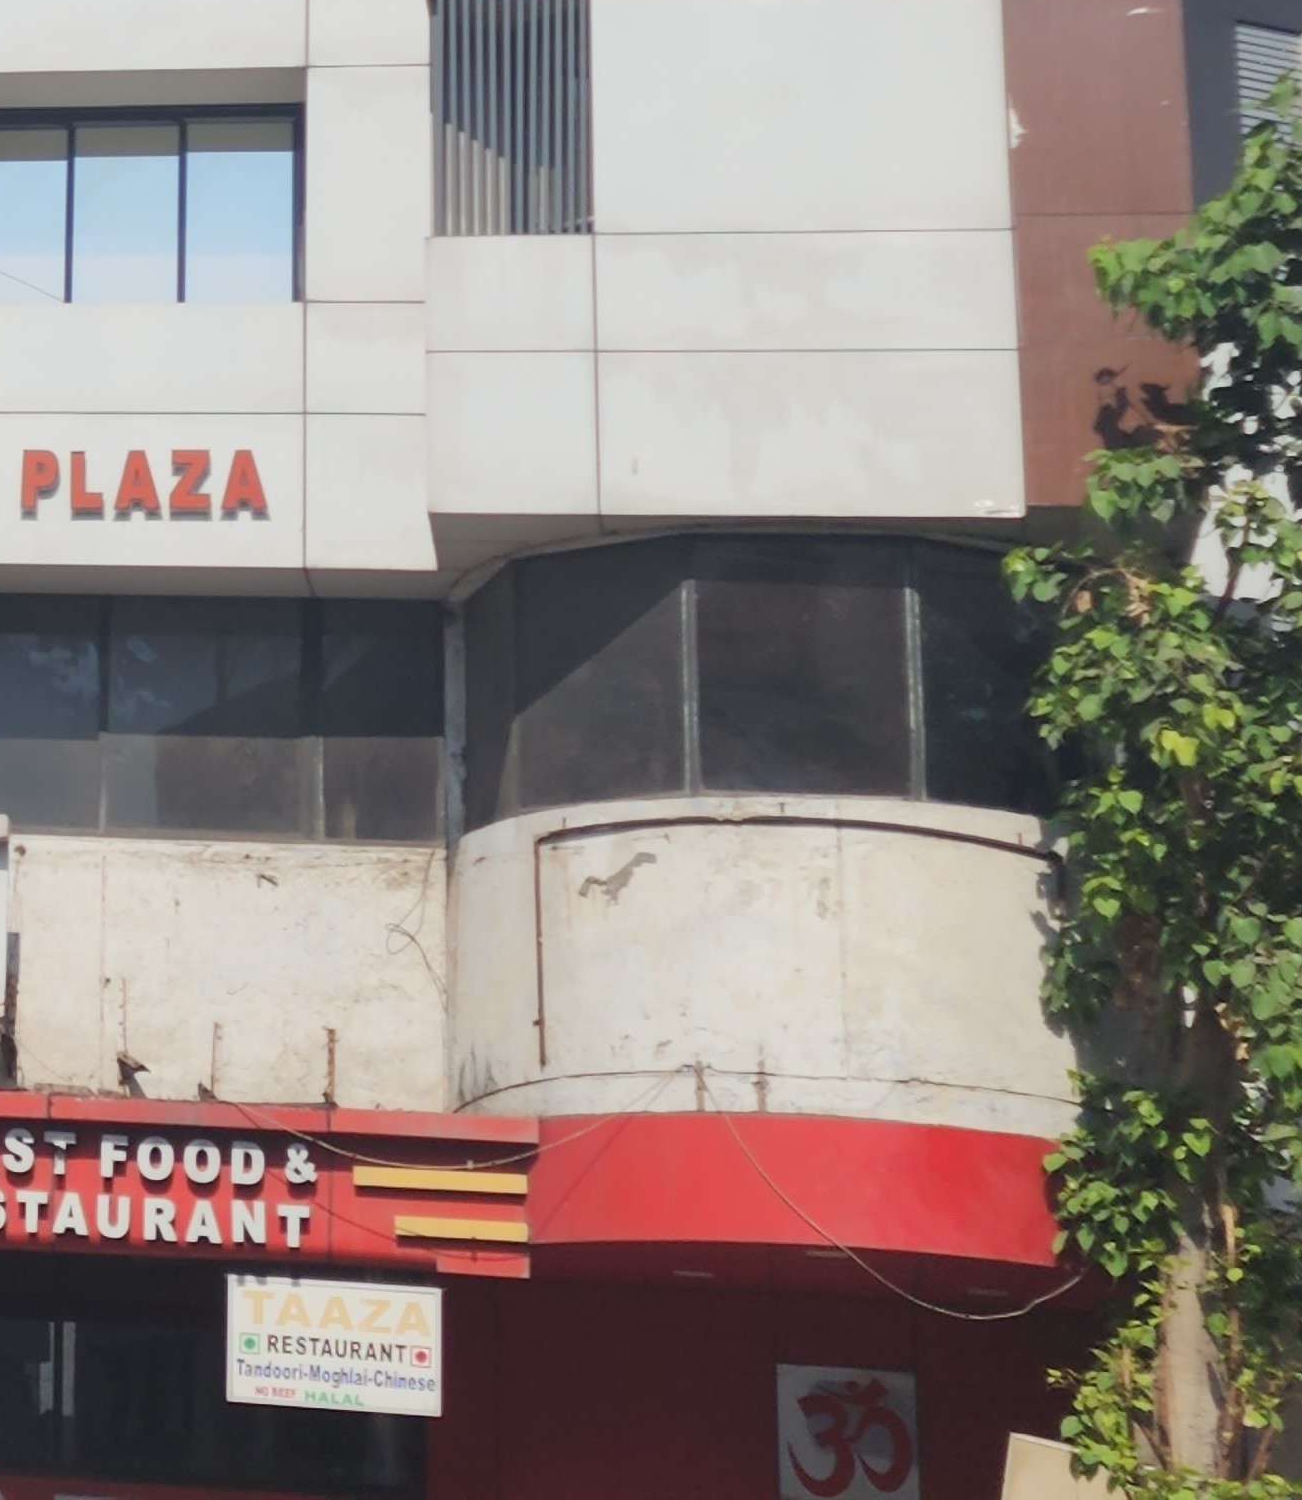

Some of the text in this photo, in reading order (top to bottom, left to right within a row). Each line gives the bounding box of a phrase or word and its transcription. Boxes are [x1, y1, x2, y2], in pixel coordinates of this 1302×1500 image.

[21, 449, 266, 512] PLAZA
[99, 1134, 266, 1185] FOOD
[283, 1143, 319, 1185] &
[241, 1289, 432, 1338] TAAZA
[266, 1333, 408, 1364] RESTAURANT
[304, 1389, 365, 1407] HALAL
